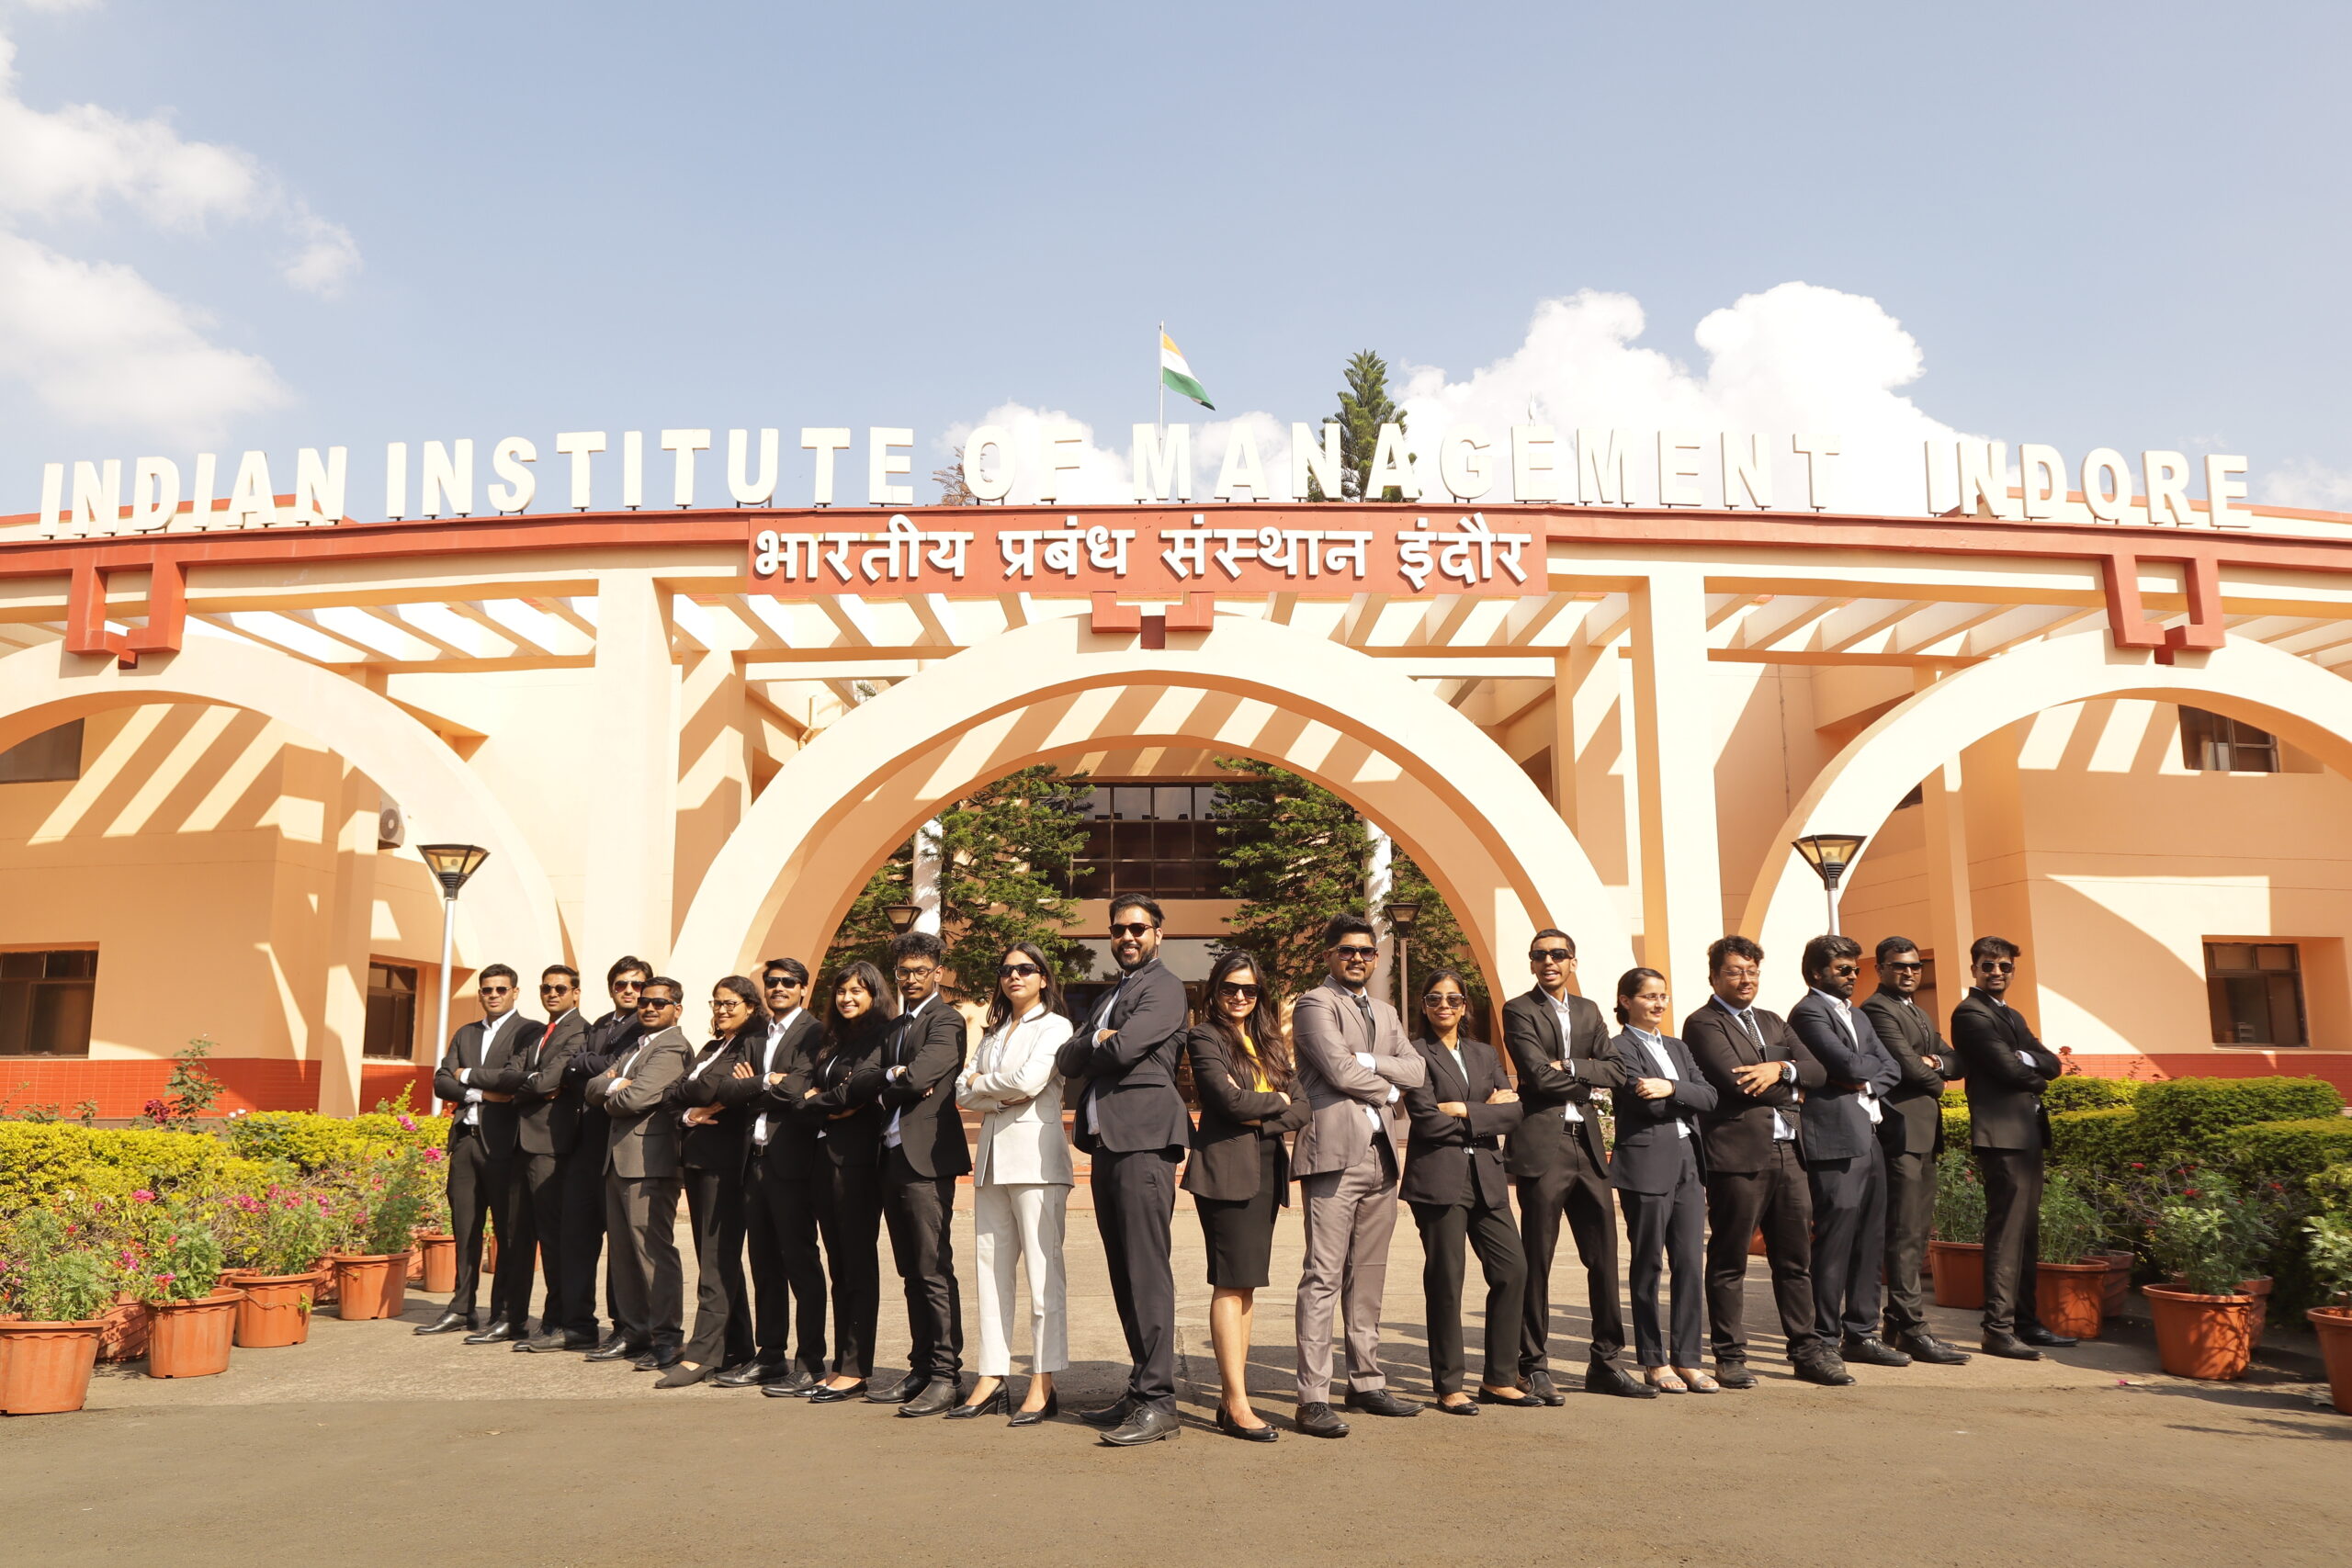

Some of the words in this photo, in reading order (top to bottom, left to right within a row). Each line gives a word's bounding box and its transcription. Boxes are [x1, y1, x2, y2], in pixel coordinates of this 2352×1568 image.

[40, 446, 347, 536] INDIAN
[386, 426, 914, 518] INSTITUTE
[963, 424, 1083, 501] OF
[1132, 423, 1840, 509] MANAGEMENT
[1924, 441, 2252, 528] INDORE
[754, 513, 974, 581] भारतीय
[998, 515, 1136, 577] प्रबंध
[1159, 513, 1373, 579] संस्थान
[1396, 512, 1532, 591] इंदौर
